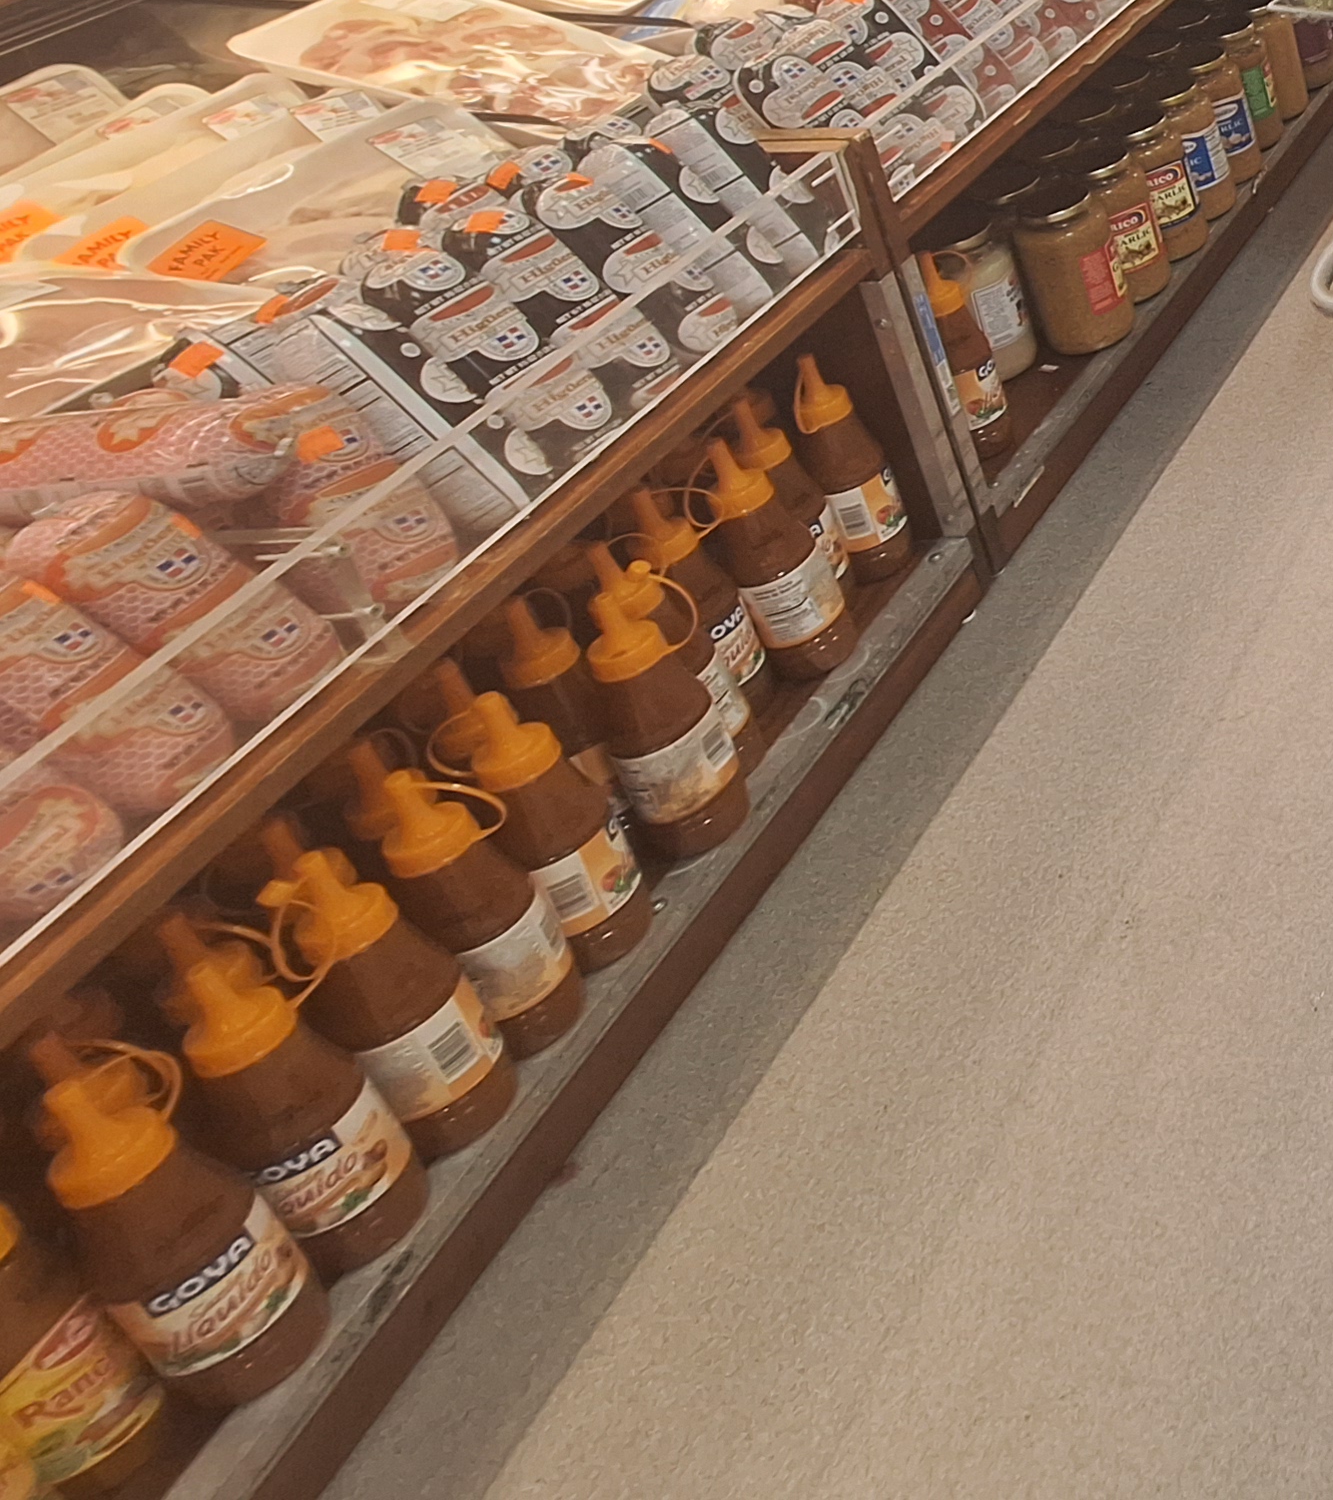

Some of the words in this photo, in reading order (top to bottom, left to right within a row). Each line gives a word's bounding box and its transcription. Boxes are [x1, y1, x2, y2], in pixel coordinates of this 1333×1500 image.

[72, 228, 134, 267] AMILY
[168, 230, 221, 273] FAMILY
[193, 244, 227, 269] PAK
[1119, 226, 1153, 248] ARLIC
[96, 249, 118, 270] PA
[709, 603, 745, 641] OYA
[258, 1136, 340, 1186] OYA
[146, 1234, 253, 1317] GOYA
[10, 1354, 114, 1430] Ranc
